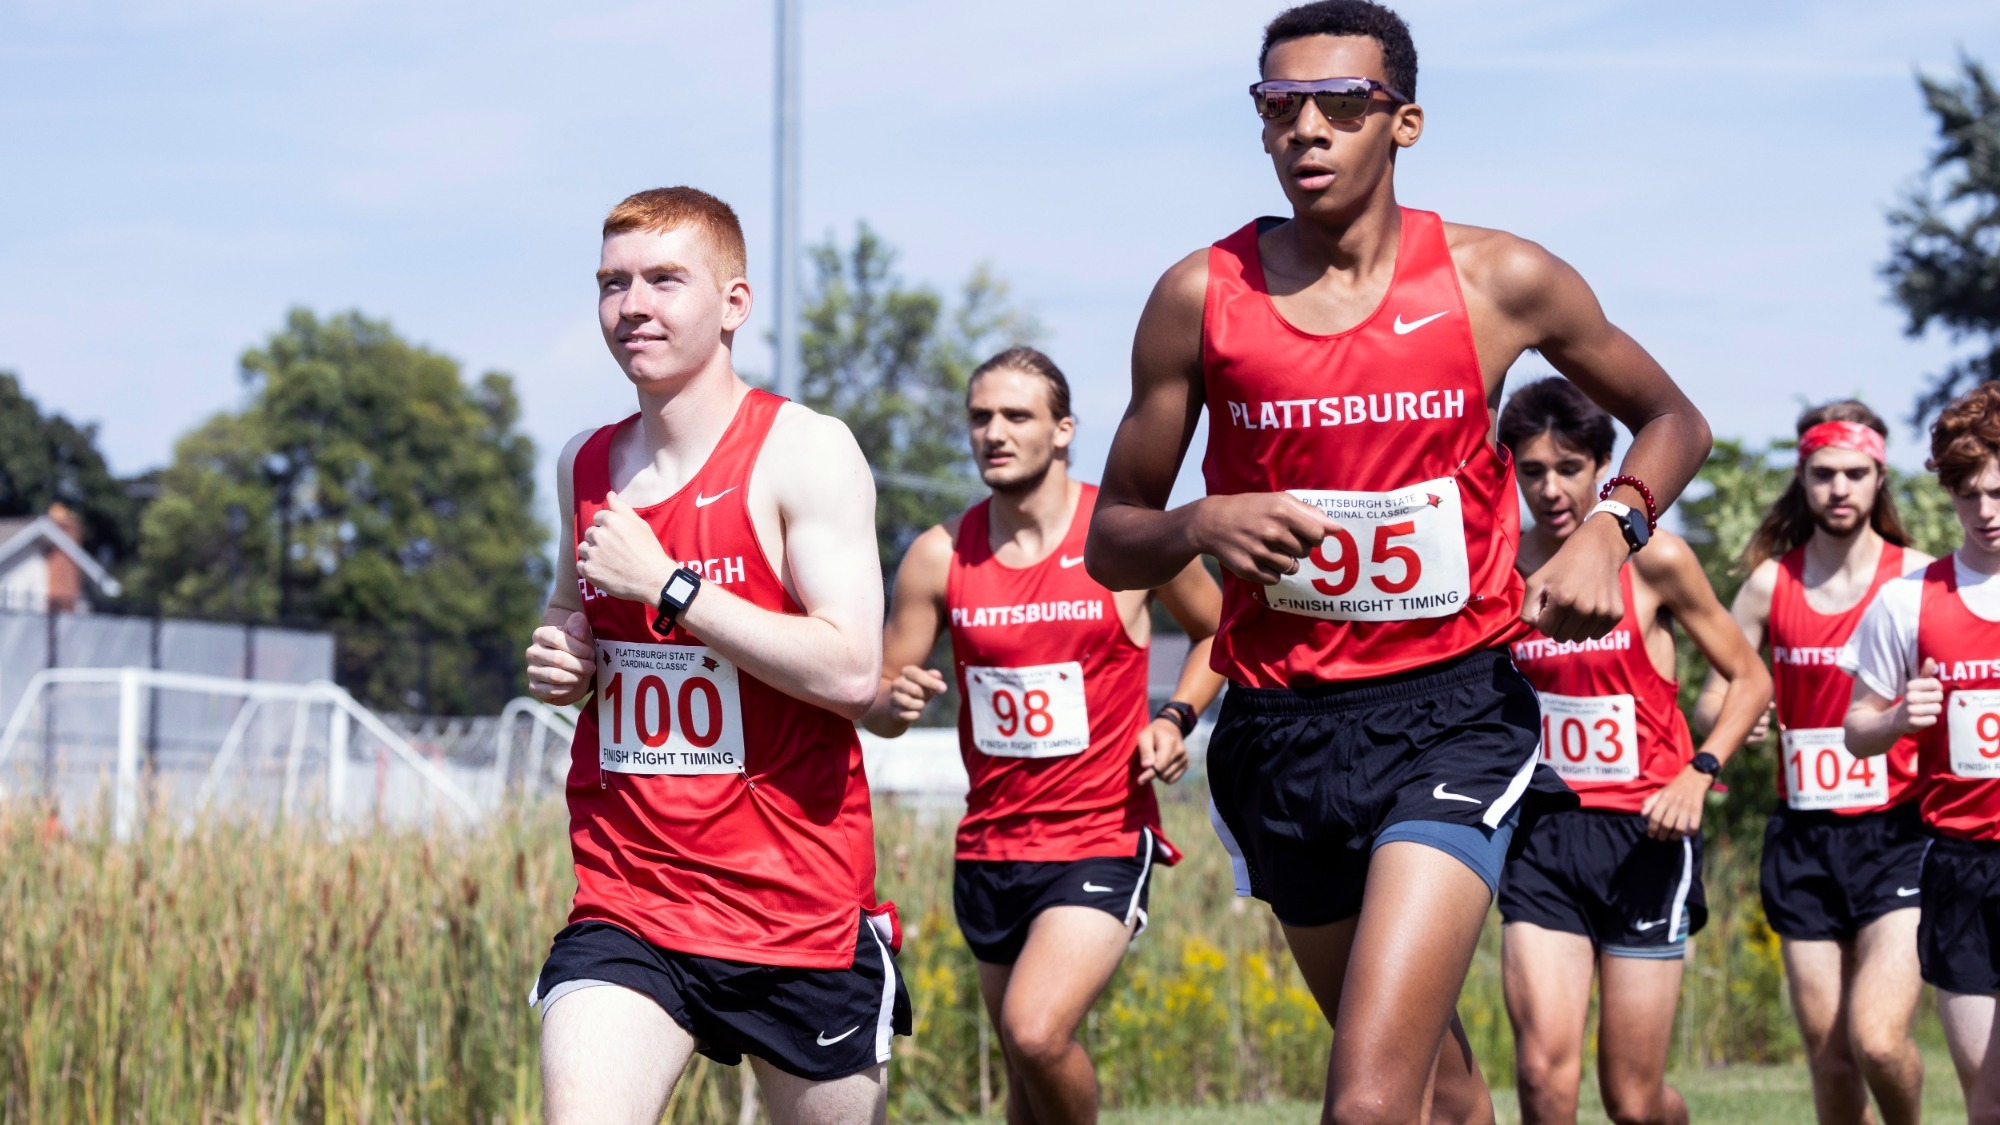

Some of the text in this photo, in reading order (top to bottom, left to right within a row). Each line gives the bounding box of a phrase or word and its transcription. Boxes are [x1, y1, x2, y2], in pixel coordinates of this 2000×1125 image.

[1227, 389, 1464, 430] PLATTSBURGH
[1302, 494, 1416, 508] PLATTSBURGH STATE
[1327, 507, 1410, 519] RDINAL CLASSIC
[1309, 520, 1422, 596] 95
[952, 600, 1103, 627] PLATTSBURGH
[1278, 591, 1459, 612] FINISH RIGHT TIMING
[615, 648, 695, 661] PLATTSBURGH STATE
[620, 659, 687, 671] CARDINAL CLASSIC
[605, 672, 723, 748] 100
[992, 689, 1054, 737] 98
[1542, 714, 1623, 763] 103
[1977, 712, 2000, 759] 9
[603, 748, 734, 765] FINISH RIGHT TIMING
[1790, 748, 1875, 791] 104
